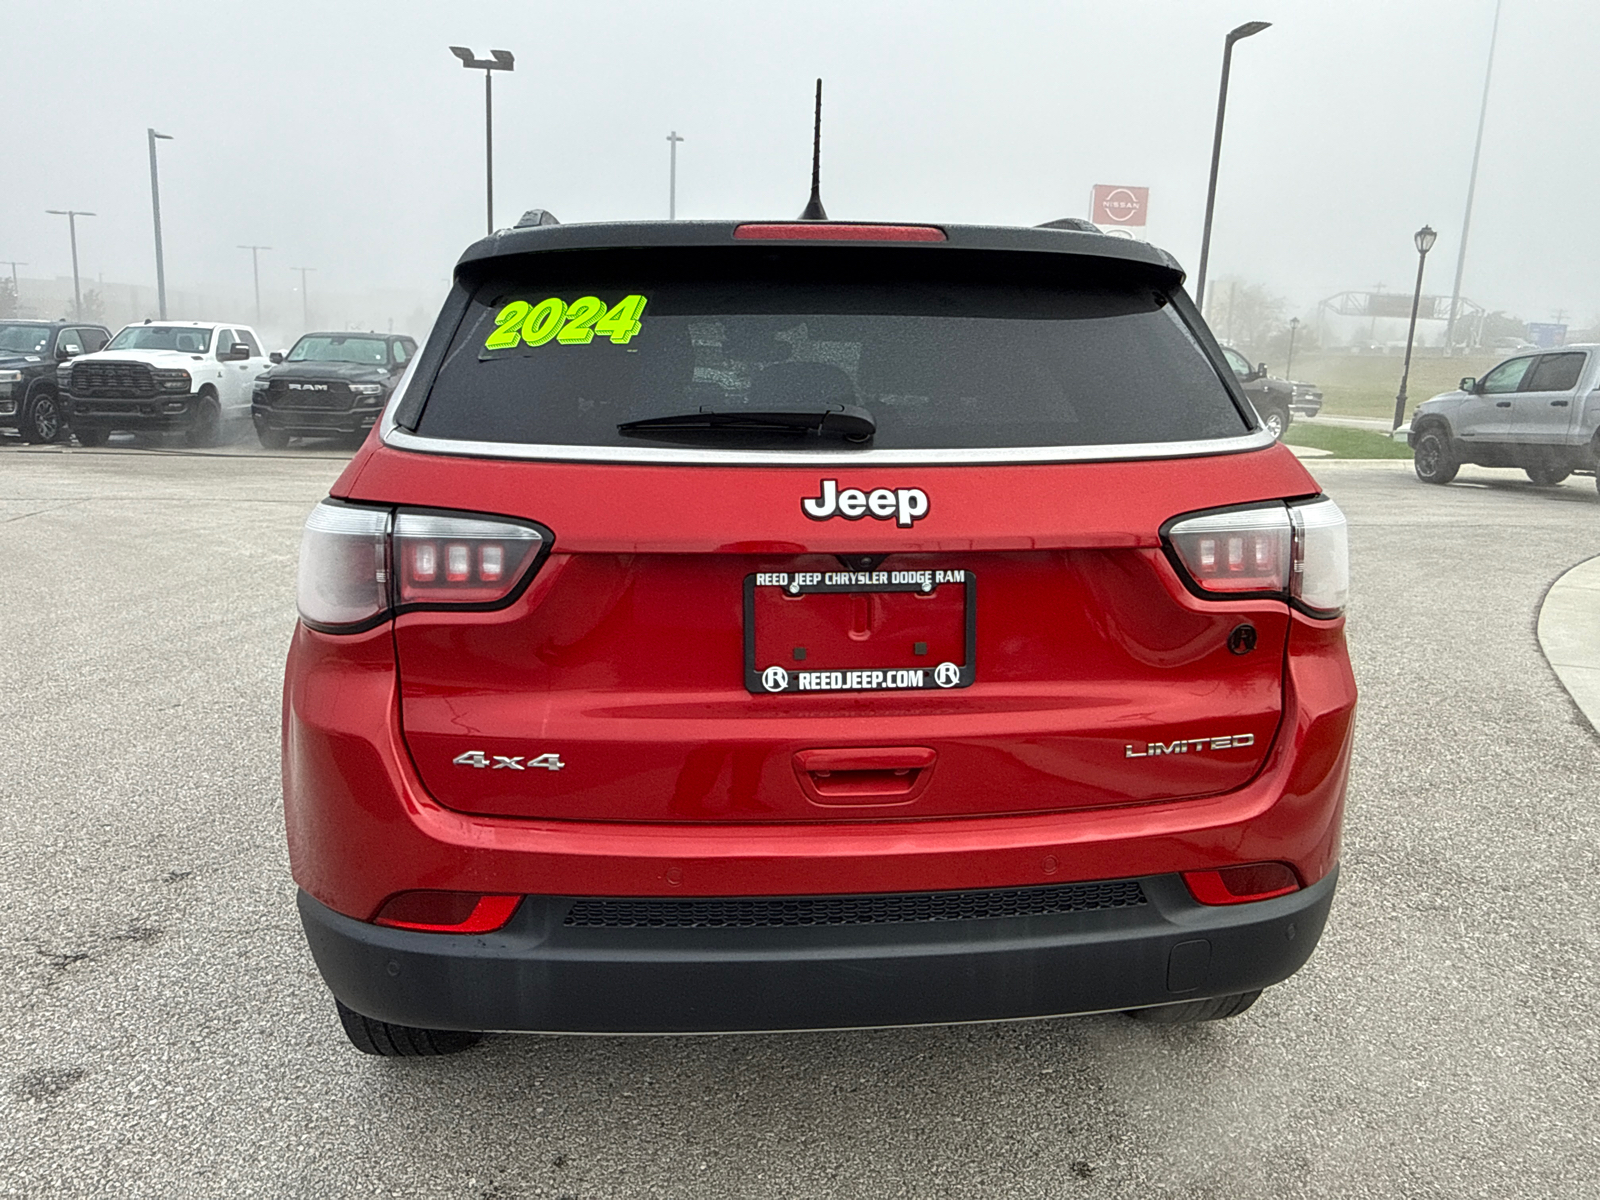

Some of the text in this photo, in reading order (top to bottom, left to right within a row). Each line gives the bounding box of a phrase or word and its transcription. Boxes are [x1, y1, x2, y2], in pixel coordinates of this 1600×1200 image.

[1103, 201, 1139, 209] NISSAN
[485, 295, 648, 350] 2024
[288, 383, 328, 391] RAM
[803, 480, 929, 526] Jeep
[756, 569, 965, 586] REED JEEP CHRYSLER DODGE RAM
[798, 669, 924, 691] REEDJEEP.COM
[1125, 733, 1255, 758] LIMITED
[452, 750, 566, 771] 4x4
